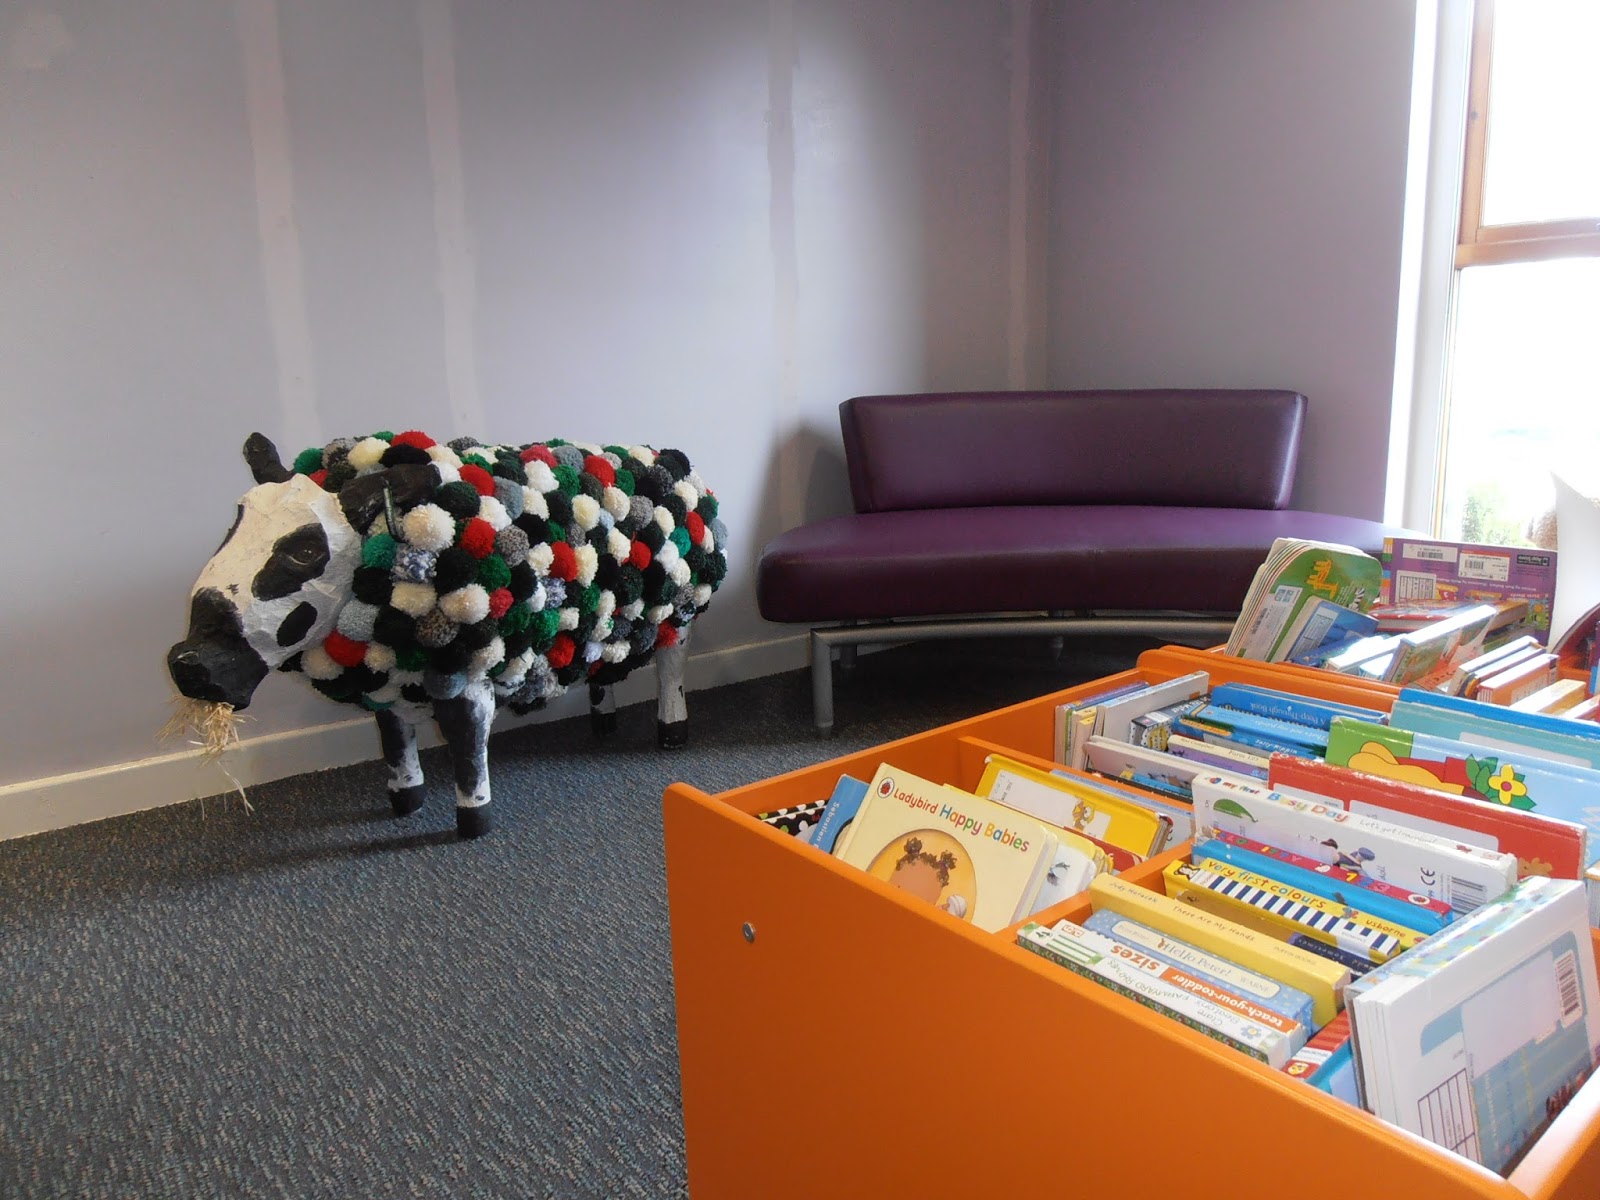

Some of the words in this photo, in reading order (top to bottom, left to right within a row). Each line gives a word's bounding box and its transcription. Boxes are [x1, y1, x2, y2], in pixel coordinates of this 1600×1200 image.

[816, 801, 840, 843] Sebastien
[893, 787, 939, 814] Ladybird
[939, 804, 982, 836] Happy
[984, 822, 1030, 852] Babies
[1208, 861, 1236, 878] very
[1238, 871, 1269, 887] first
[1270, 885, 1327, 908] colours
[1173, 906, 1195, 918] These
[1199, 915, 1212, 924] Are
[1214, 922, 1226, 932] My
[1228, 926, 1256, 942] Hands
[1366, 919, 1406, 938] usborne
[1110, 944, 1160, 970] sizes
[1164, 942, 1196, 963] Hello
[1199, 957, 1232, 978] Peter!
[1172, 972, 1284, 1028] teach-your-toddler
